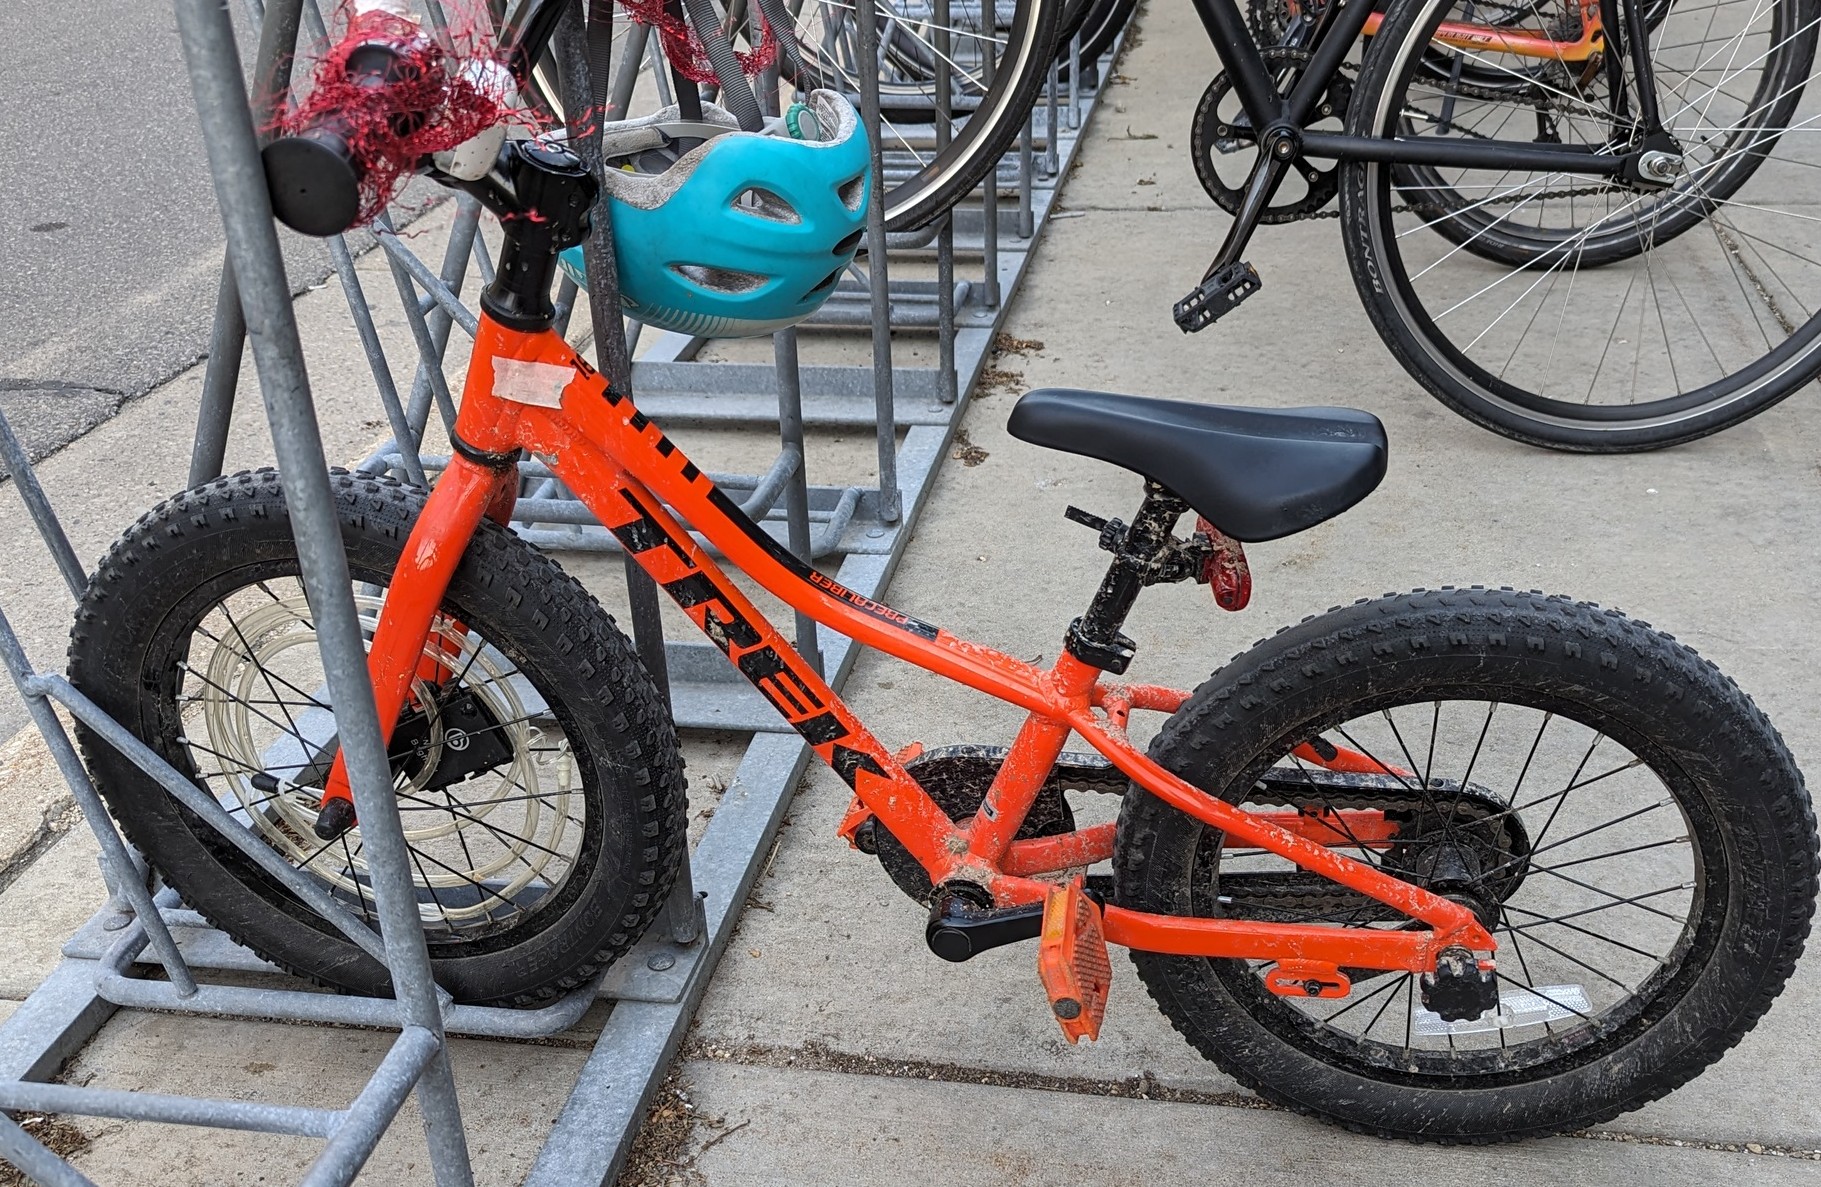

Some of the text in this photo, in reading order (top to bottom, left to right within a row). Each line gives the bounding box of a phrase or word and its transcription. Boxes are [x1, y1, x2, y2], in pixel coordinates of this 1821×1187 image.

[1356, 160, 1383, 295] BONTRAG
[612, 487, 893, 793] TREK
[809, 571, 909, 625] PRECALIBER
